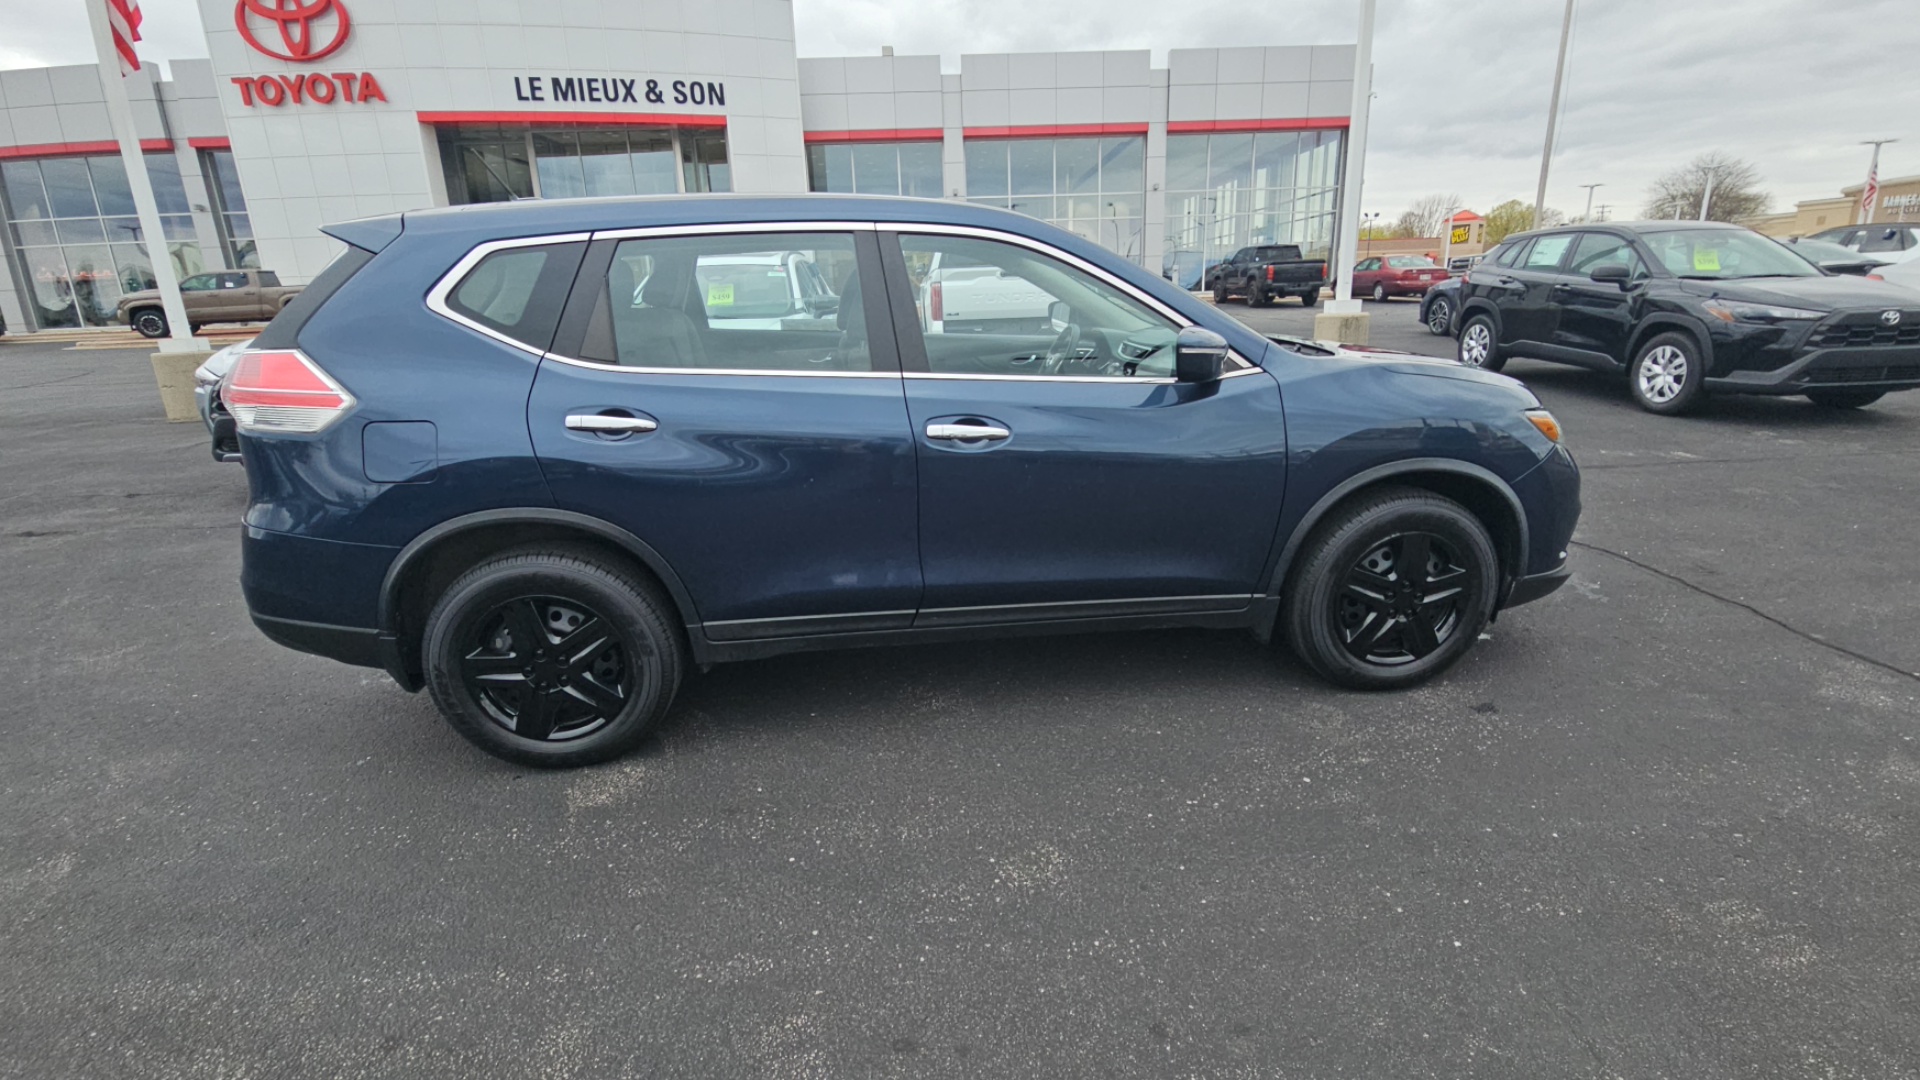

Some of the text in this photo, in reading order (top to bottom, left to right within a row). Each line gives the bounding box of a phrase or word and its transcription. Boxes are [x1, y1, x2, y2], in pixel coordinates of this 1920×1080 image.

[231, 72, 388, 107] TOYOTA
[514, 76, 726, 106] LE MIEUX & SON
